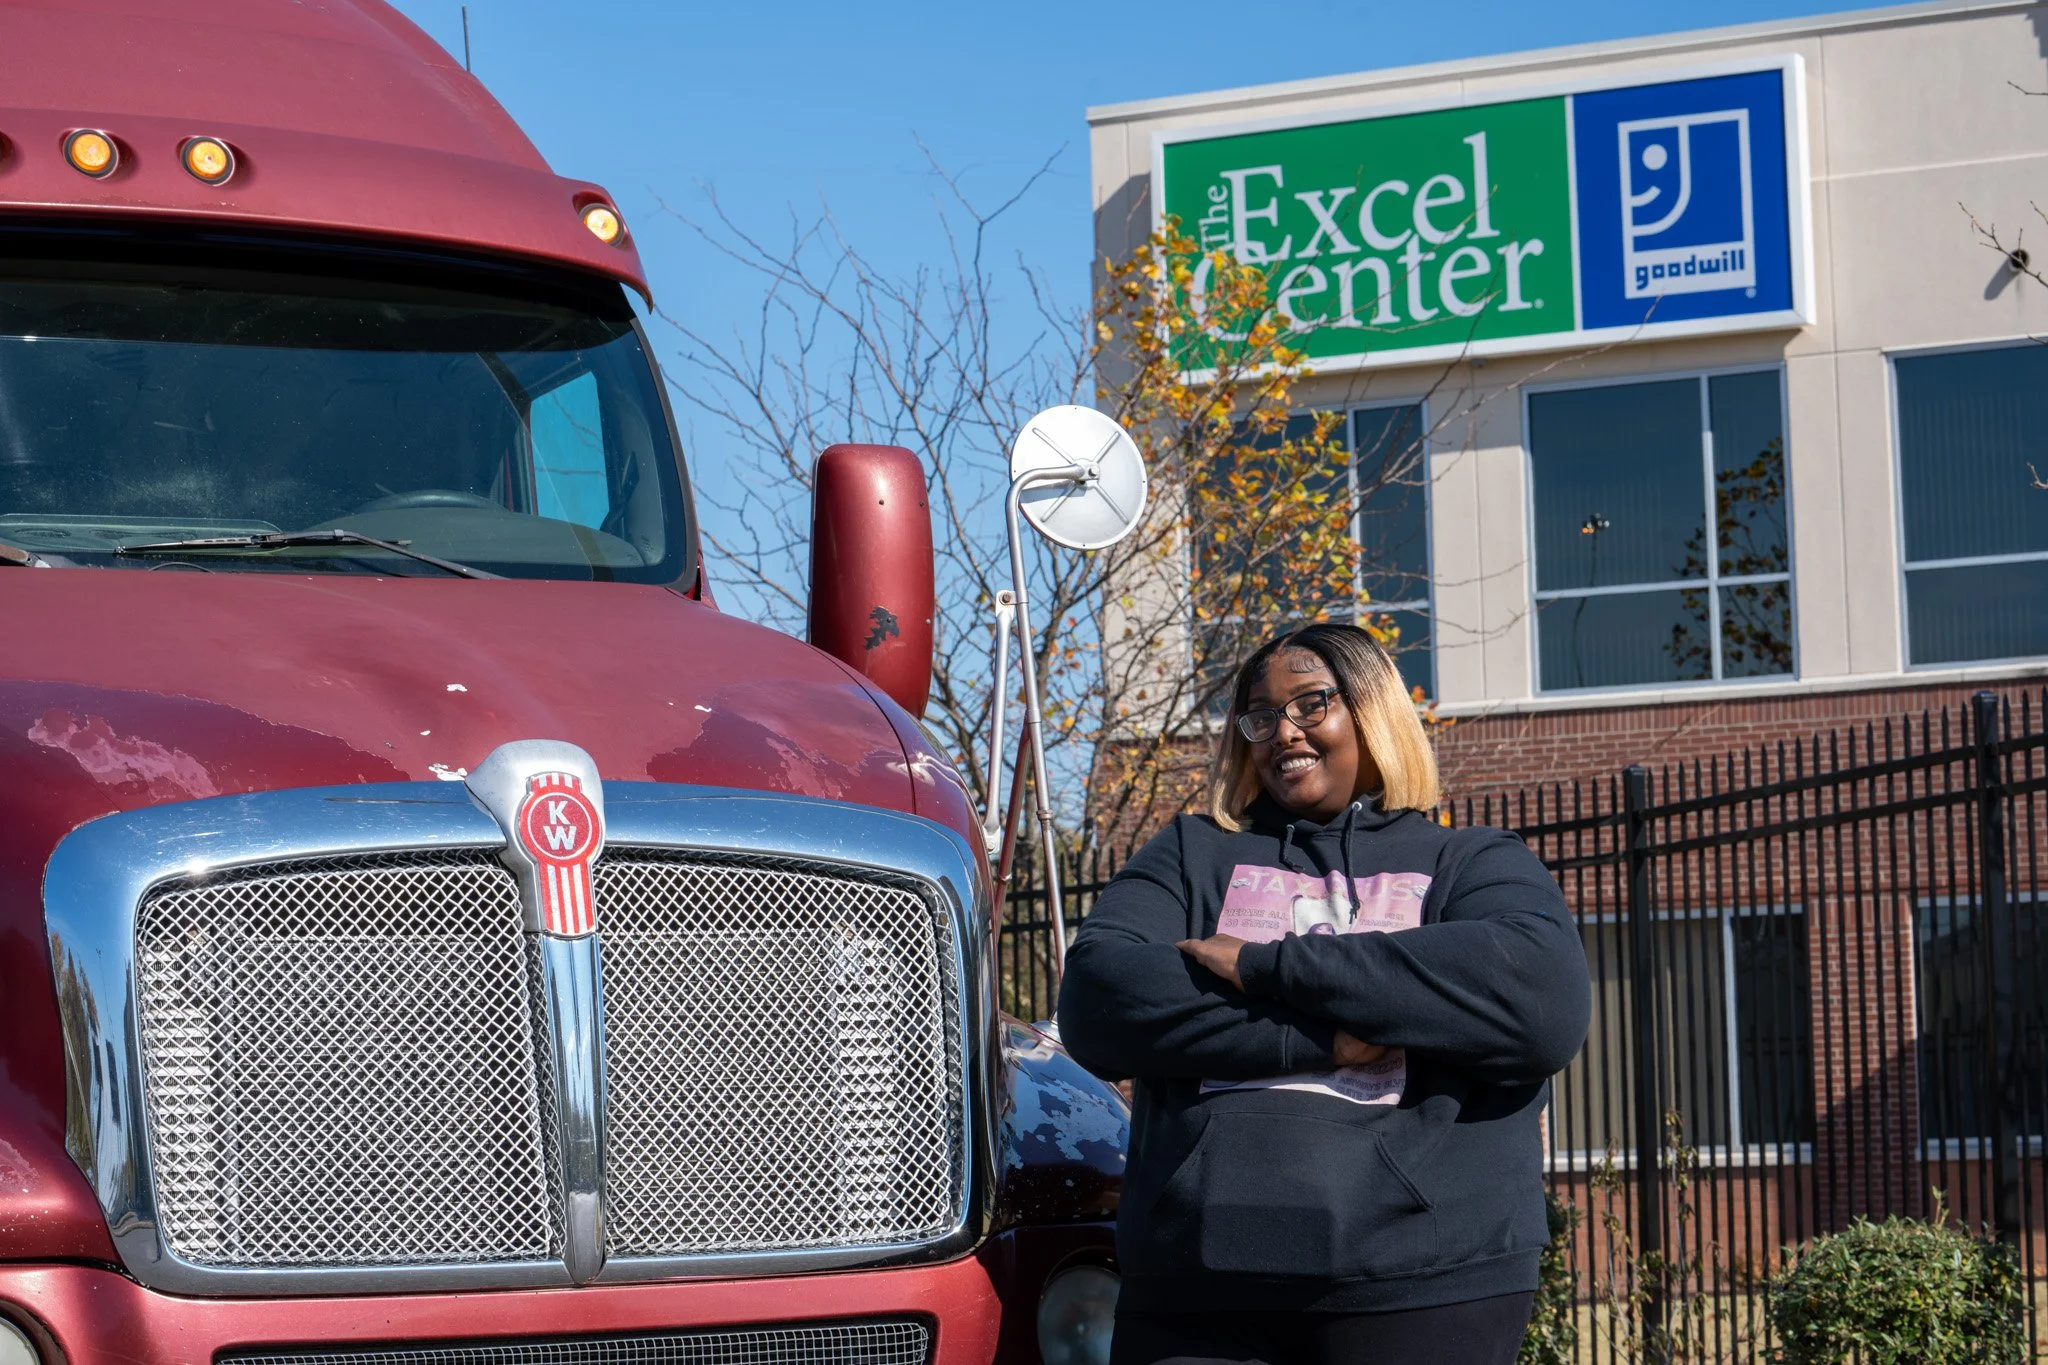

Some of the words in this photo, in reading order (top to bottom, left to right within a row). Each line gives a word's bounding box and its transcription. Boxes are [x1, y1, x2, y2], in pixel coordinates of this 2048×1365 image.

[1198, 184, 1230, 252] The
[1219, 130, 1500, 265] Excel
[1189, 234, 1544, 342] Center
[1635, 247, 1746, 291] goodwill
[543, 825, 577, 851] W
[547, 800, 571, 826] K
